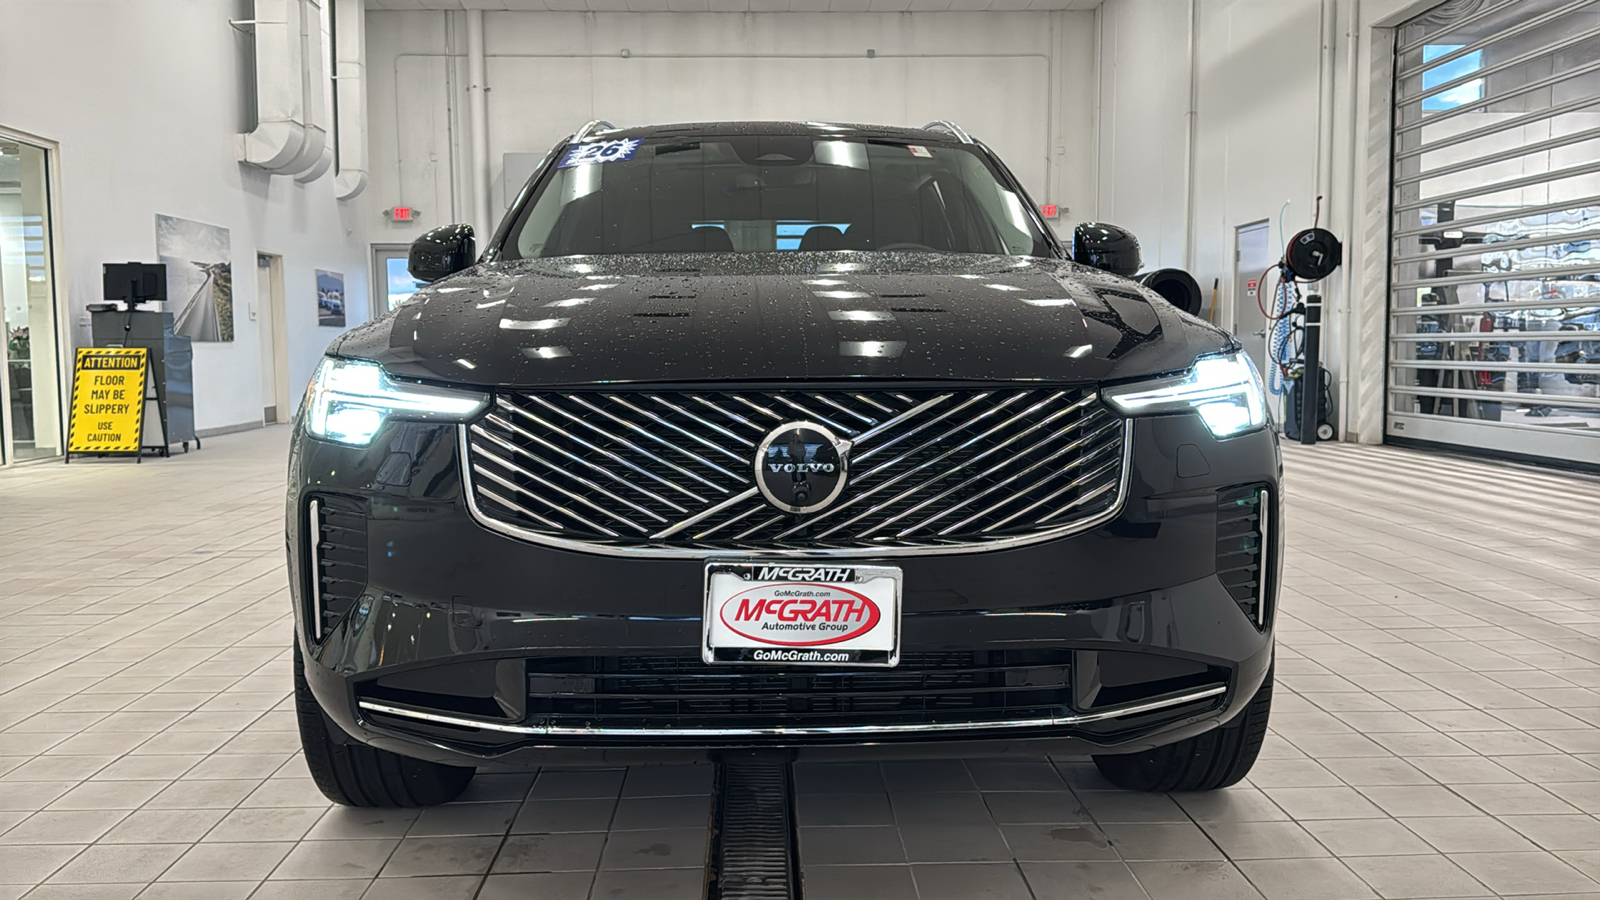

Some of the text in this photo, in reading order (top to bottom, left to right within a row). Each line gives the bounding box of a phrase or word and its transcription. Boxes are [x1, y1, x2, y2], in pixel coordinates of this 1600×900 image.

[394, 207, 410, 219] EXIT
[83, 357, 138, 368] ATTENTION
[94, 375, 125, 386] FLOOR
[91, 389, 126, 400] MAY BE
[84, 403, 130, 414] SLIPPERY
[97, 421, 113, 430] USE
[87, 433, 122, 442] CAUTION
[768, 462, 835, 473] VOLVO
[761, 621, 849, 633] Automotive Group
[753, 649, 850, 662] GoMcGrath.com
